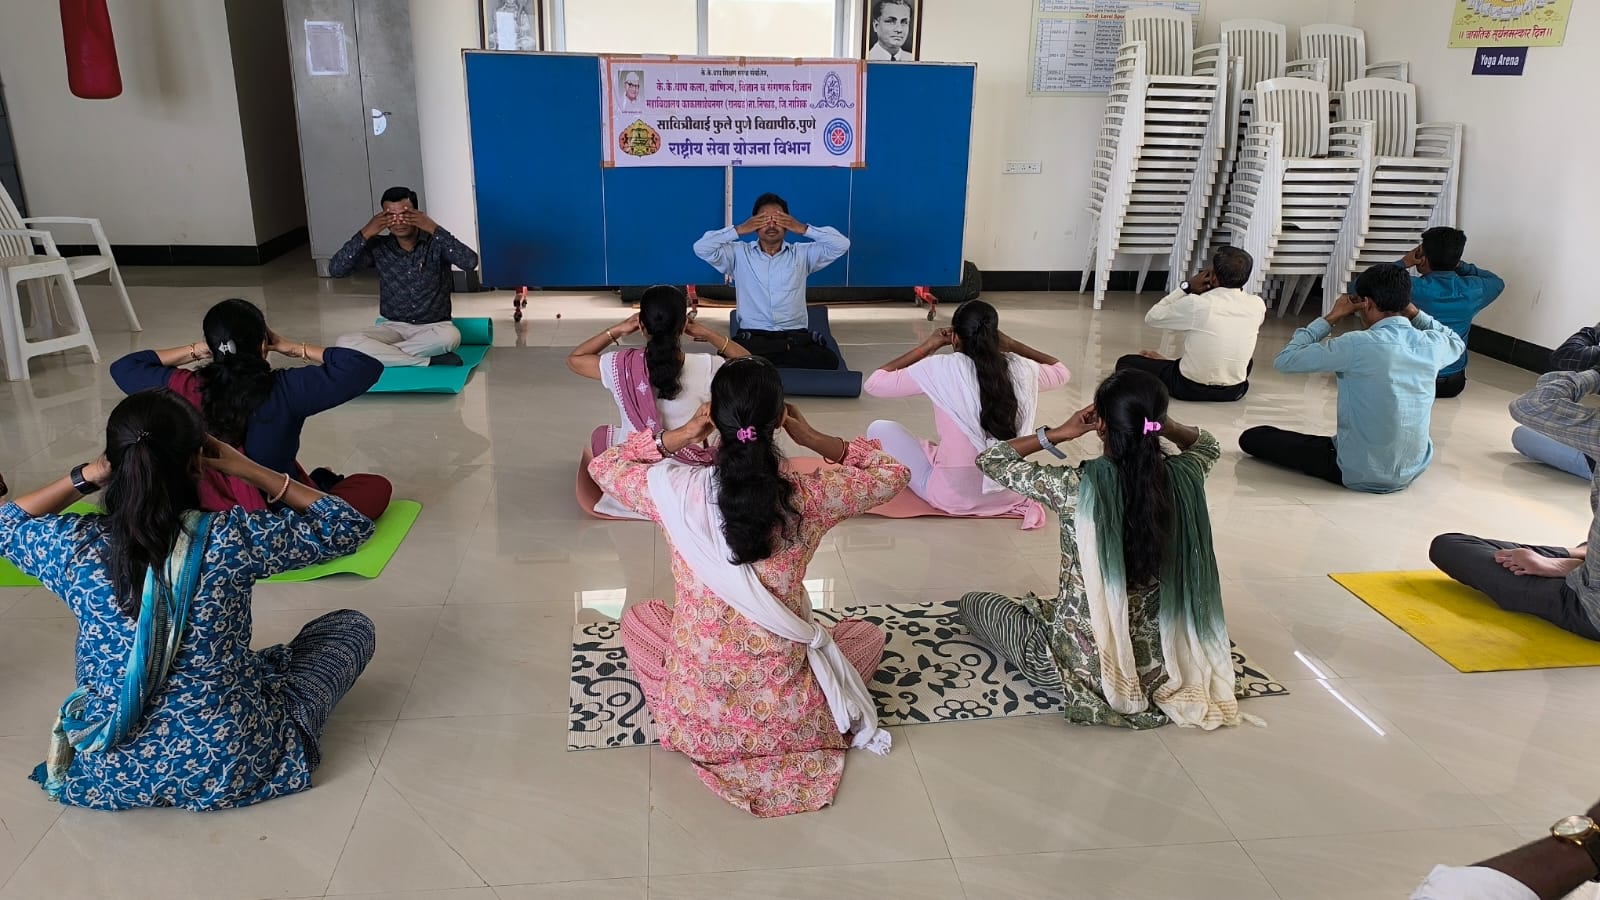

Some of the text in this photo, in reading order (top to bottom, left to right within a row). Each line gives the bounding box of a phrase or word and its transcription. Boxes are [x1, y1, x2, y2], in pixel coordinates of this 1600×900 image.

[1480, 54, 1519, 68] Yoga Arena
[738, 80, 759, 92] विज्ञान
[792, 80, 812, 92] विज्ञान
[657, 116, 711, 131] सावित्रीबाई
[713, 116, 732, 134] फुले
[735, 116, 752, 134] पुणे
[668, 137, 811, 159] राष्ट्रीय सेवा योजना विभाग
